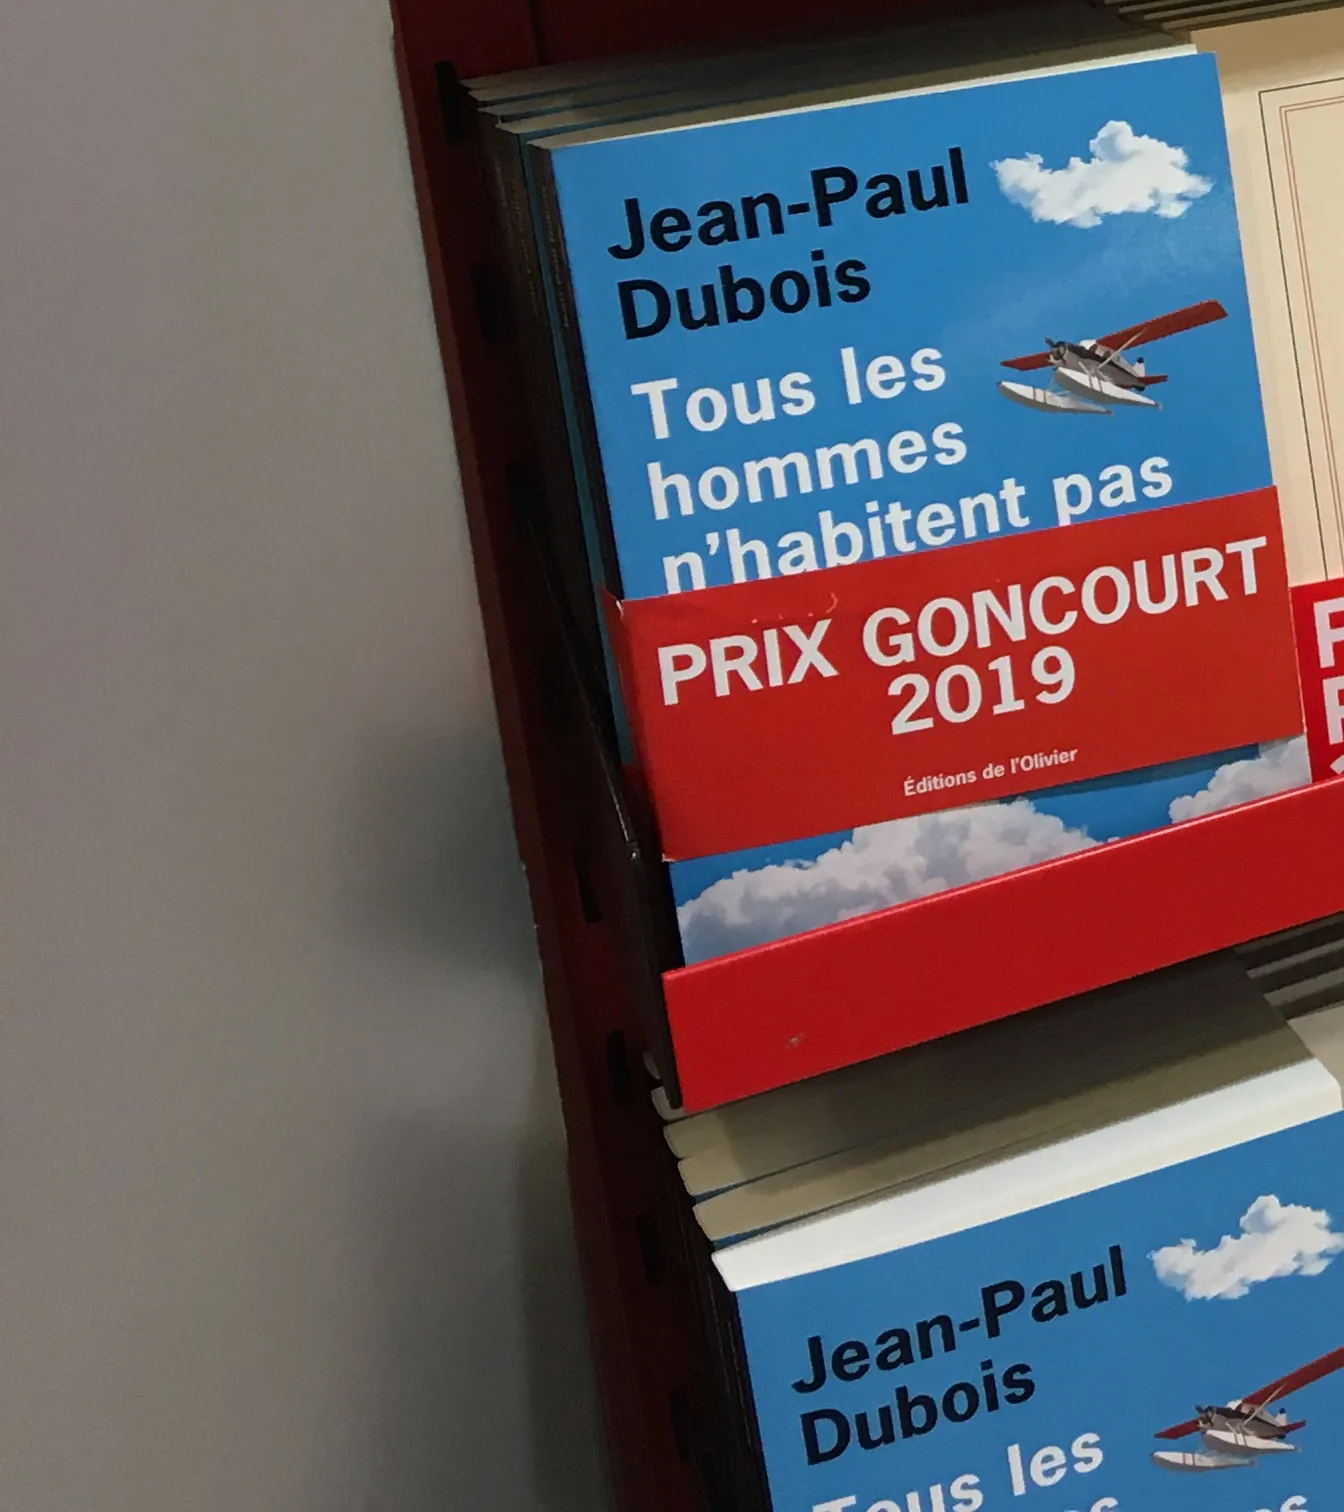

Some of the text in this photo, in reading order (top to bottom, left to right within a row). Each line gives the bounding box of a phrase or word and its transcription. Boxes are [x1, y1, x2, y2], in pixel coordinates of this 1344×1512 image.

[656, 535, 1268, 707] PRIX GONCOURT
[886, 646, 1077, 736] 2019
[902, 744, 1079, 798] Éditions de l'Olivier
[791, 1243, 1128, 1395] Jean-Paul
[799, 1358, 1037, 1467] Dubois
